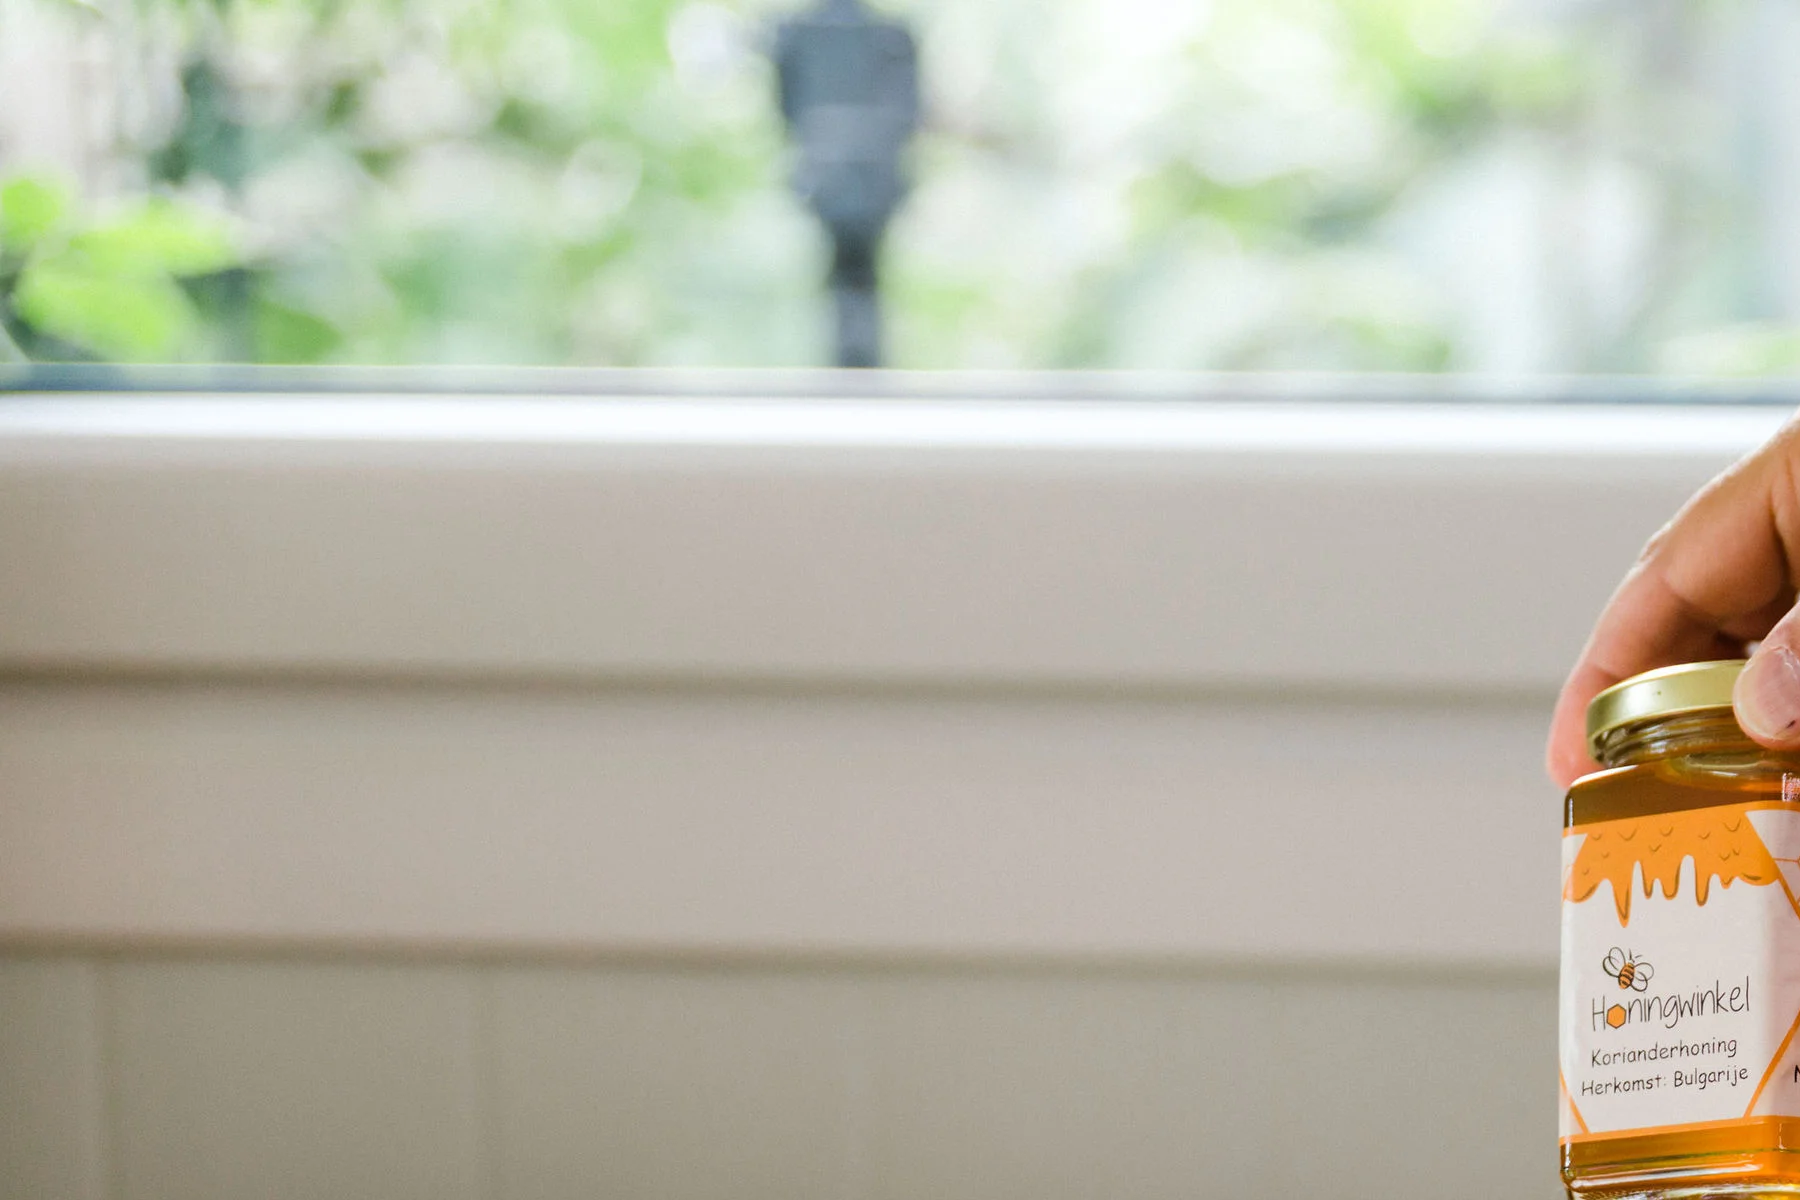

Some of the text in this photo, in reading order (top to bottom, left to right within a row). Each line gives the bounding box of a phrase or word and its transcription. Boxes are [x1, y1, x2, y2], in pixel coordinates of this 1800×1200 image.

[1592, 975, 1750, 1031] Honingwinkel
[1591, 1037, 1737, 1068] Korianderhoning
[1581, 1065, 1749, 1096] Herkomst: Bulgarije
